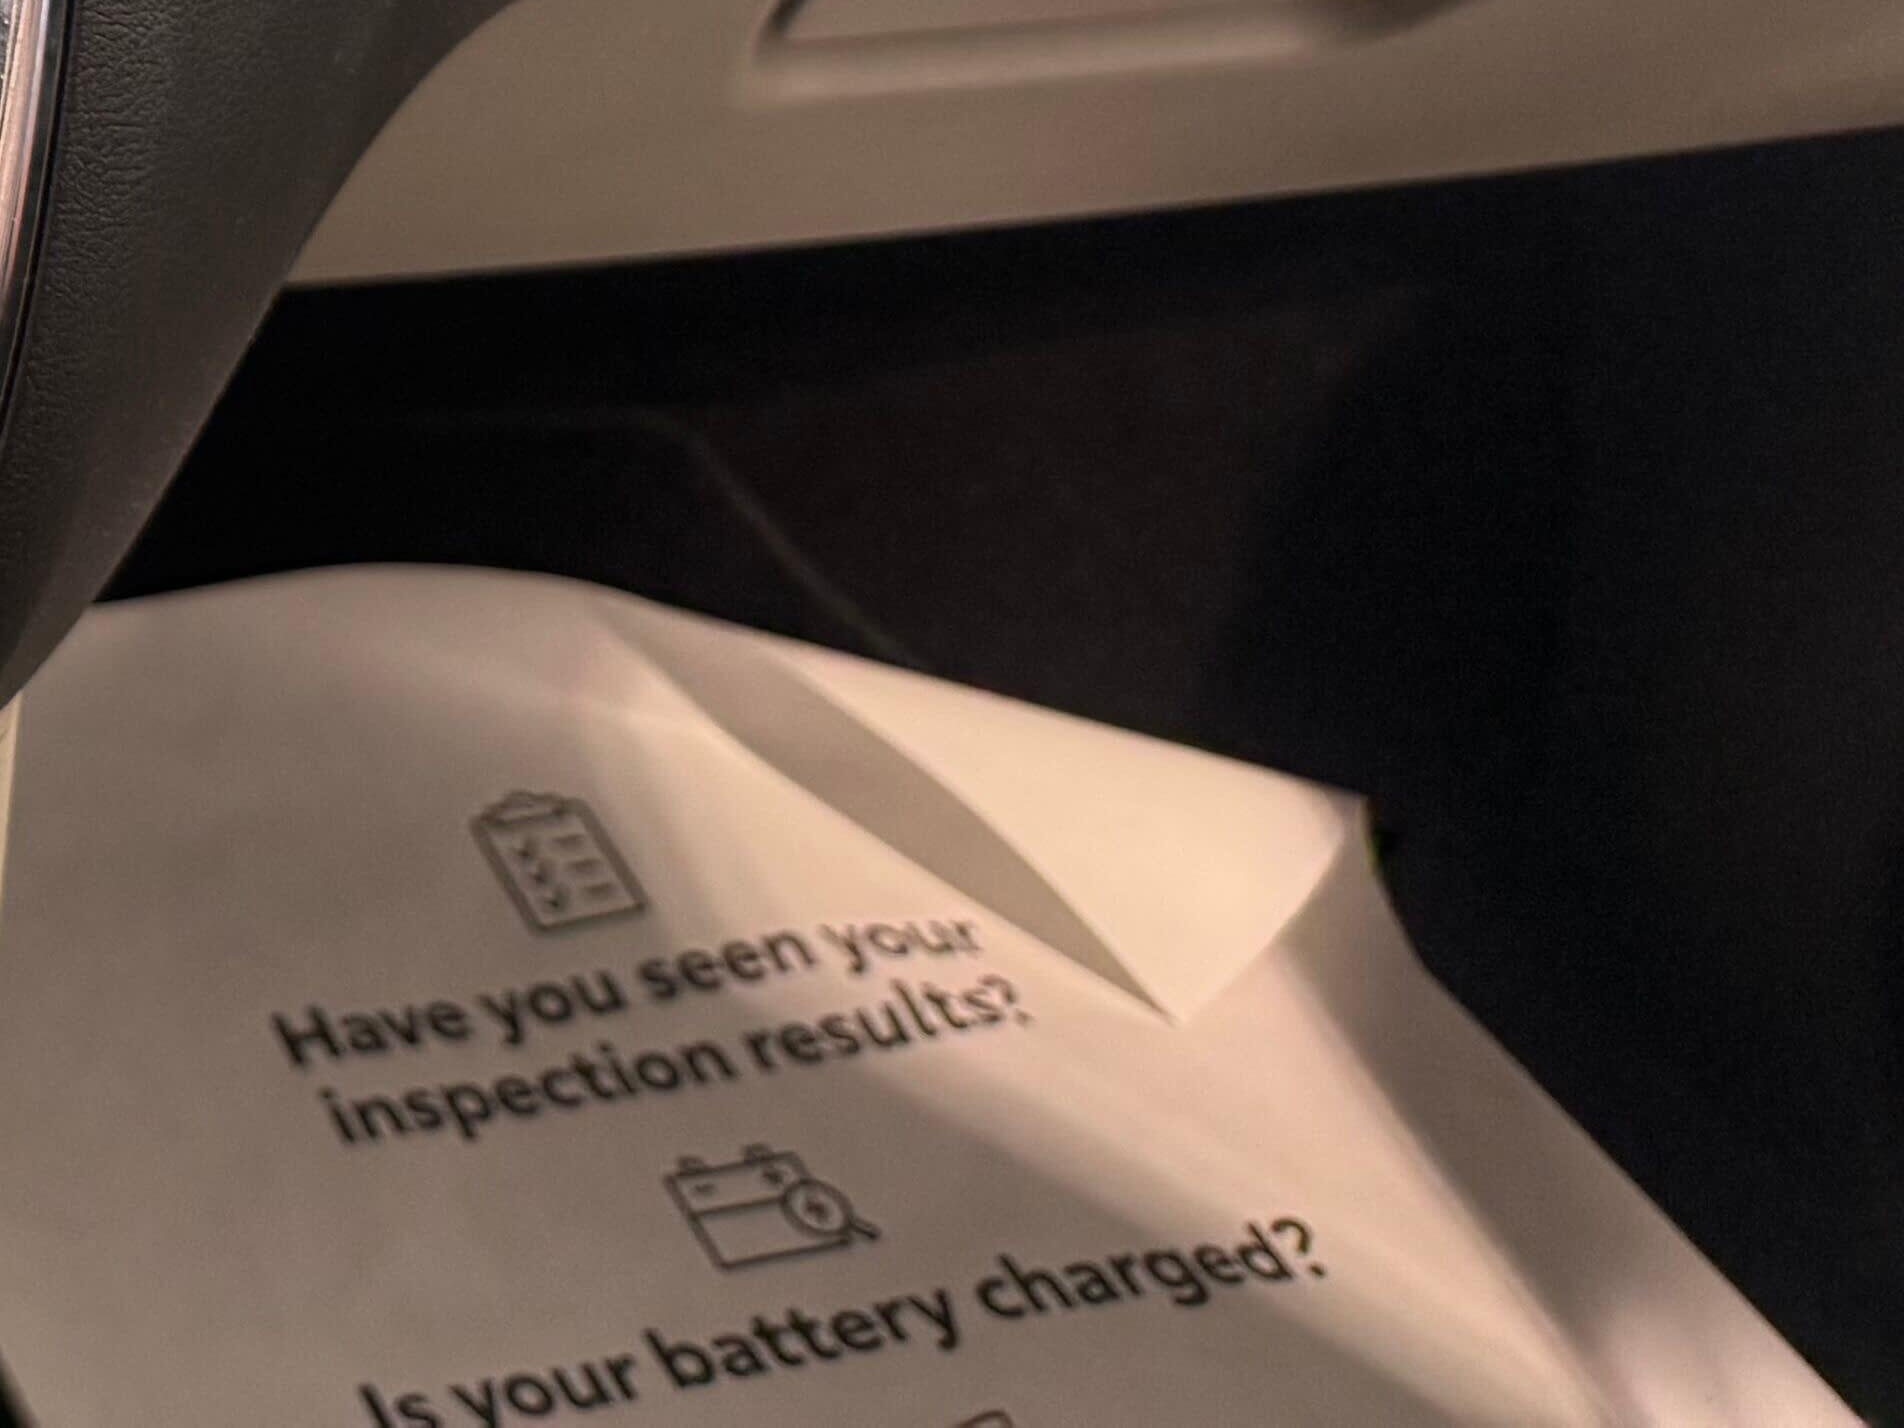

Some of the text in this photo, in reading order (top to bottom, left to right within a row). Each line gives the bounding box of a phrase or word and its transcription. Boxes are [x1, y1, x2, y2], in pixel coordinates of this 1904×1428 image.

[272, 918, 982, 1067] Have you seen your
[320, 974, 1034, 1142] inspection results?
[362, 1219, 1325, 1428] Is your battery charged?
